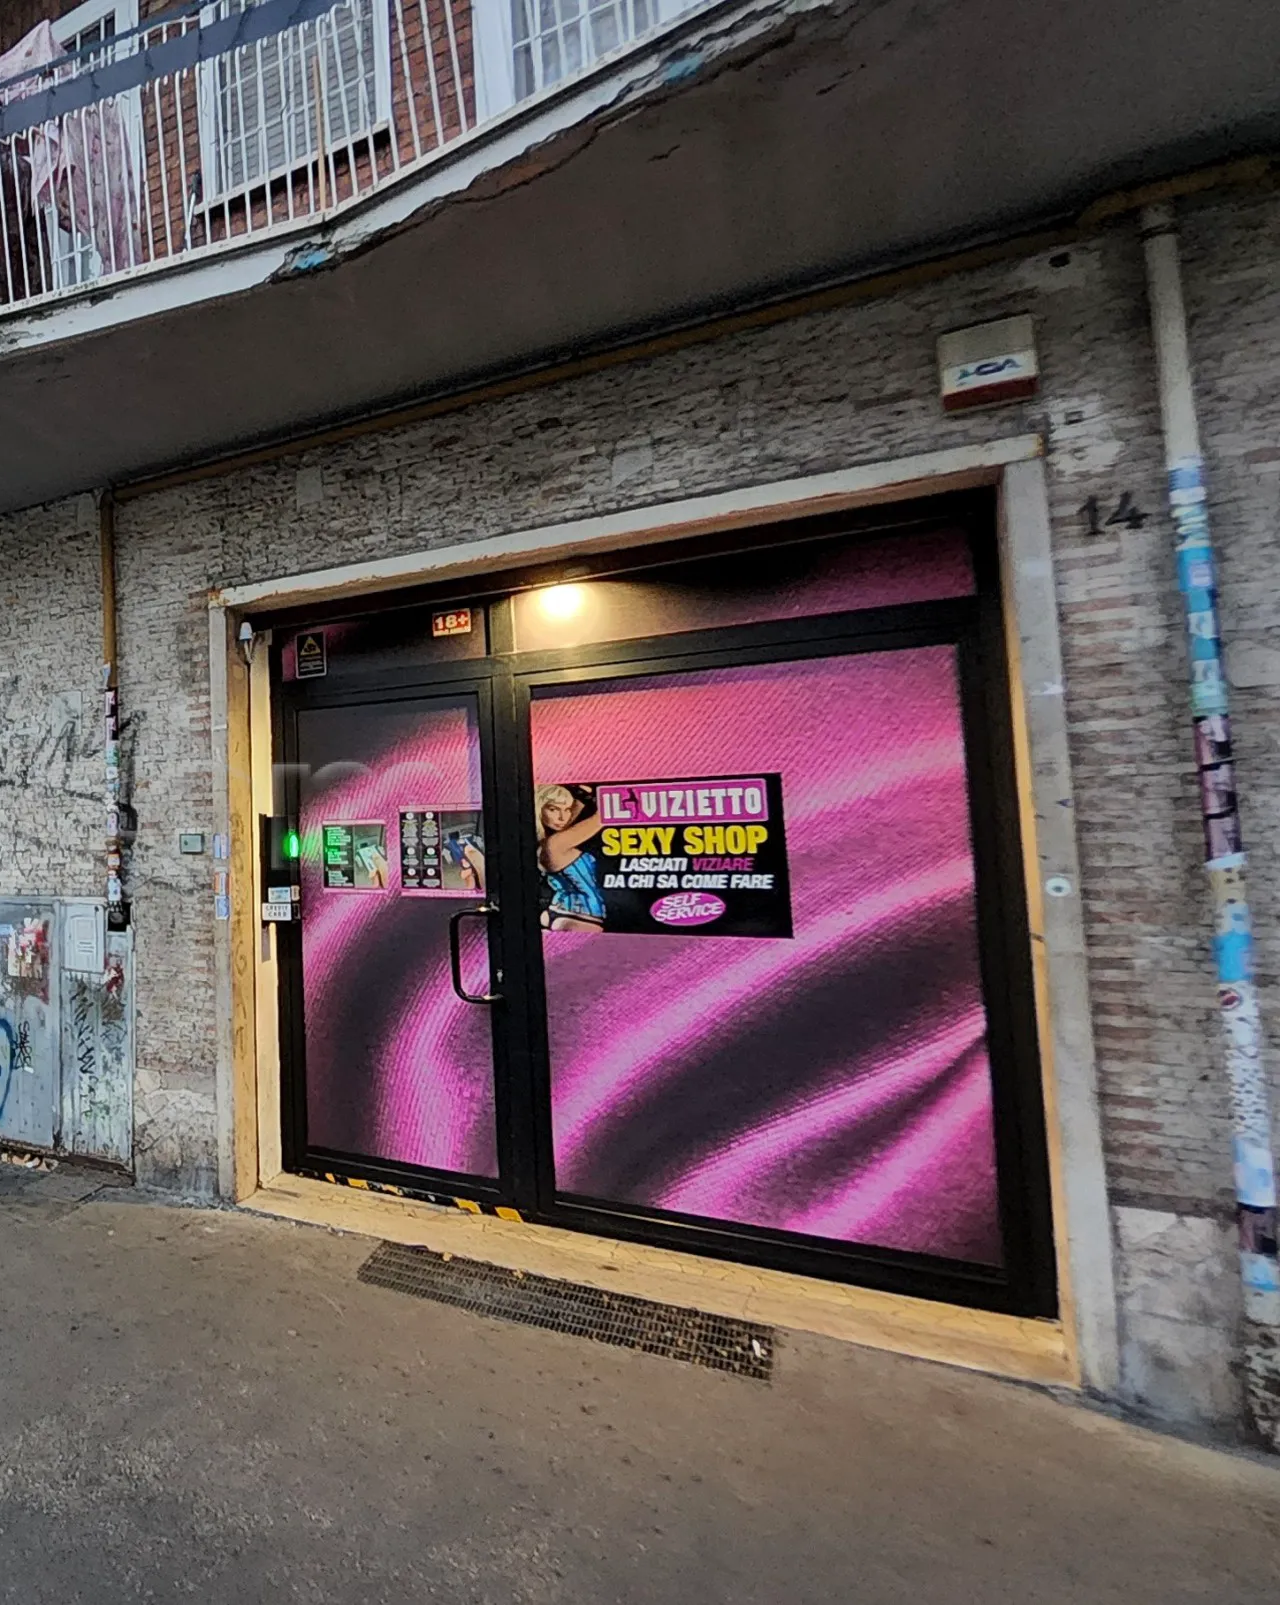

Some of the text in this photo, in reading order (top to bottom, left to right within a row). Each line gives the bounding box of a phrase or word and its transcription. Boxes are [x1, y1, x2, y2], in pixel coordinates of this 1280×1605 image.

[1077, 491, 1151, 536] 14
[435, 614, 469, 630] 18+
[603, 787, 762, 819] IL VIZIETTO
[601, 825, 769, 856] SEXY SHOP
[619, 857, 756, 872] LASCIATI VIZIARE
[603, 874, 773, 889] DA CHI SA COME FARE
[661, 892, 702, 907] SELF
[655, 902, 723, 922] SERVICE
